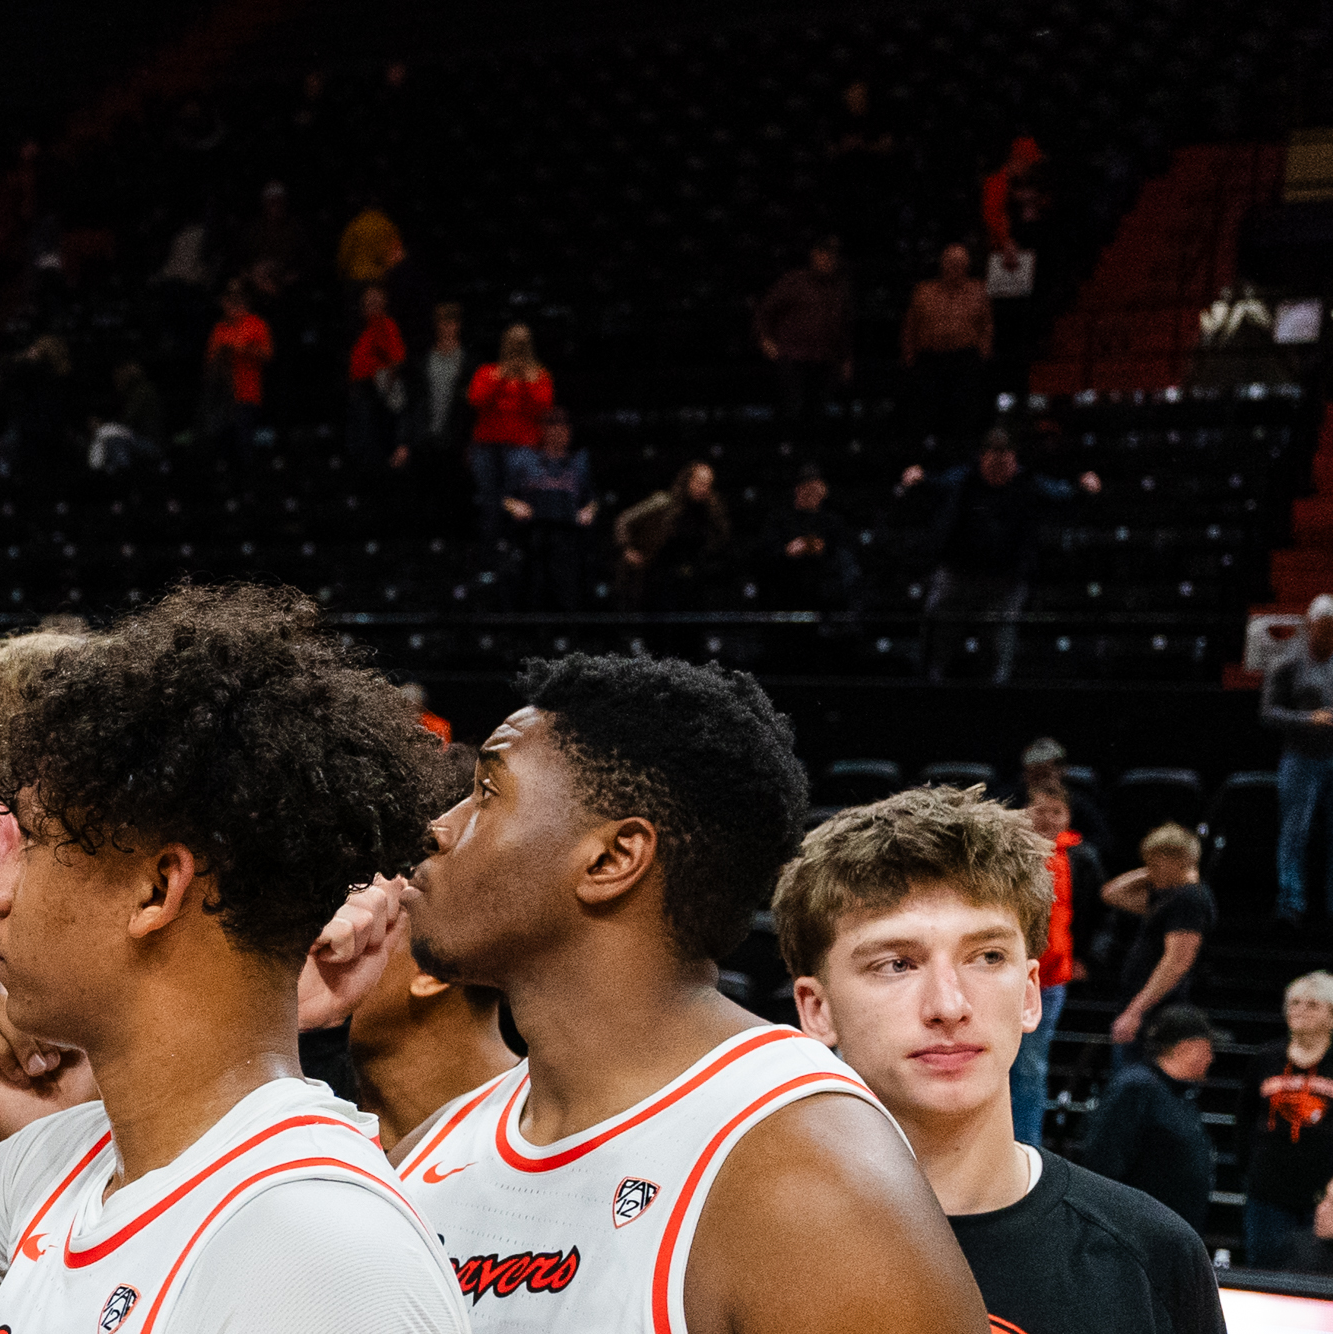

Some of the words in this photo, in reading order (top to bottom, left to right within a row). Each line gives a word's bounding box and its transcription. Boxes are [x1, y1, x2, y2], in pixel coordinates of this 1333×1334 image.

[616, 1198, 640, 1218] 12
[441, 1238, 581, 1307] avers
[100, 1307, 121, 1331] 12
